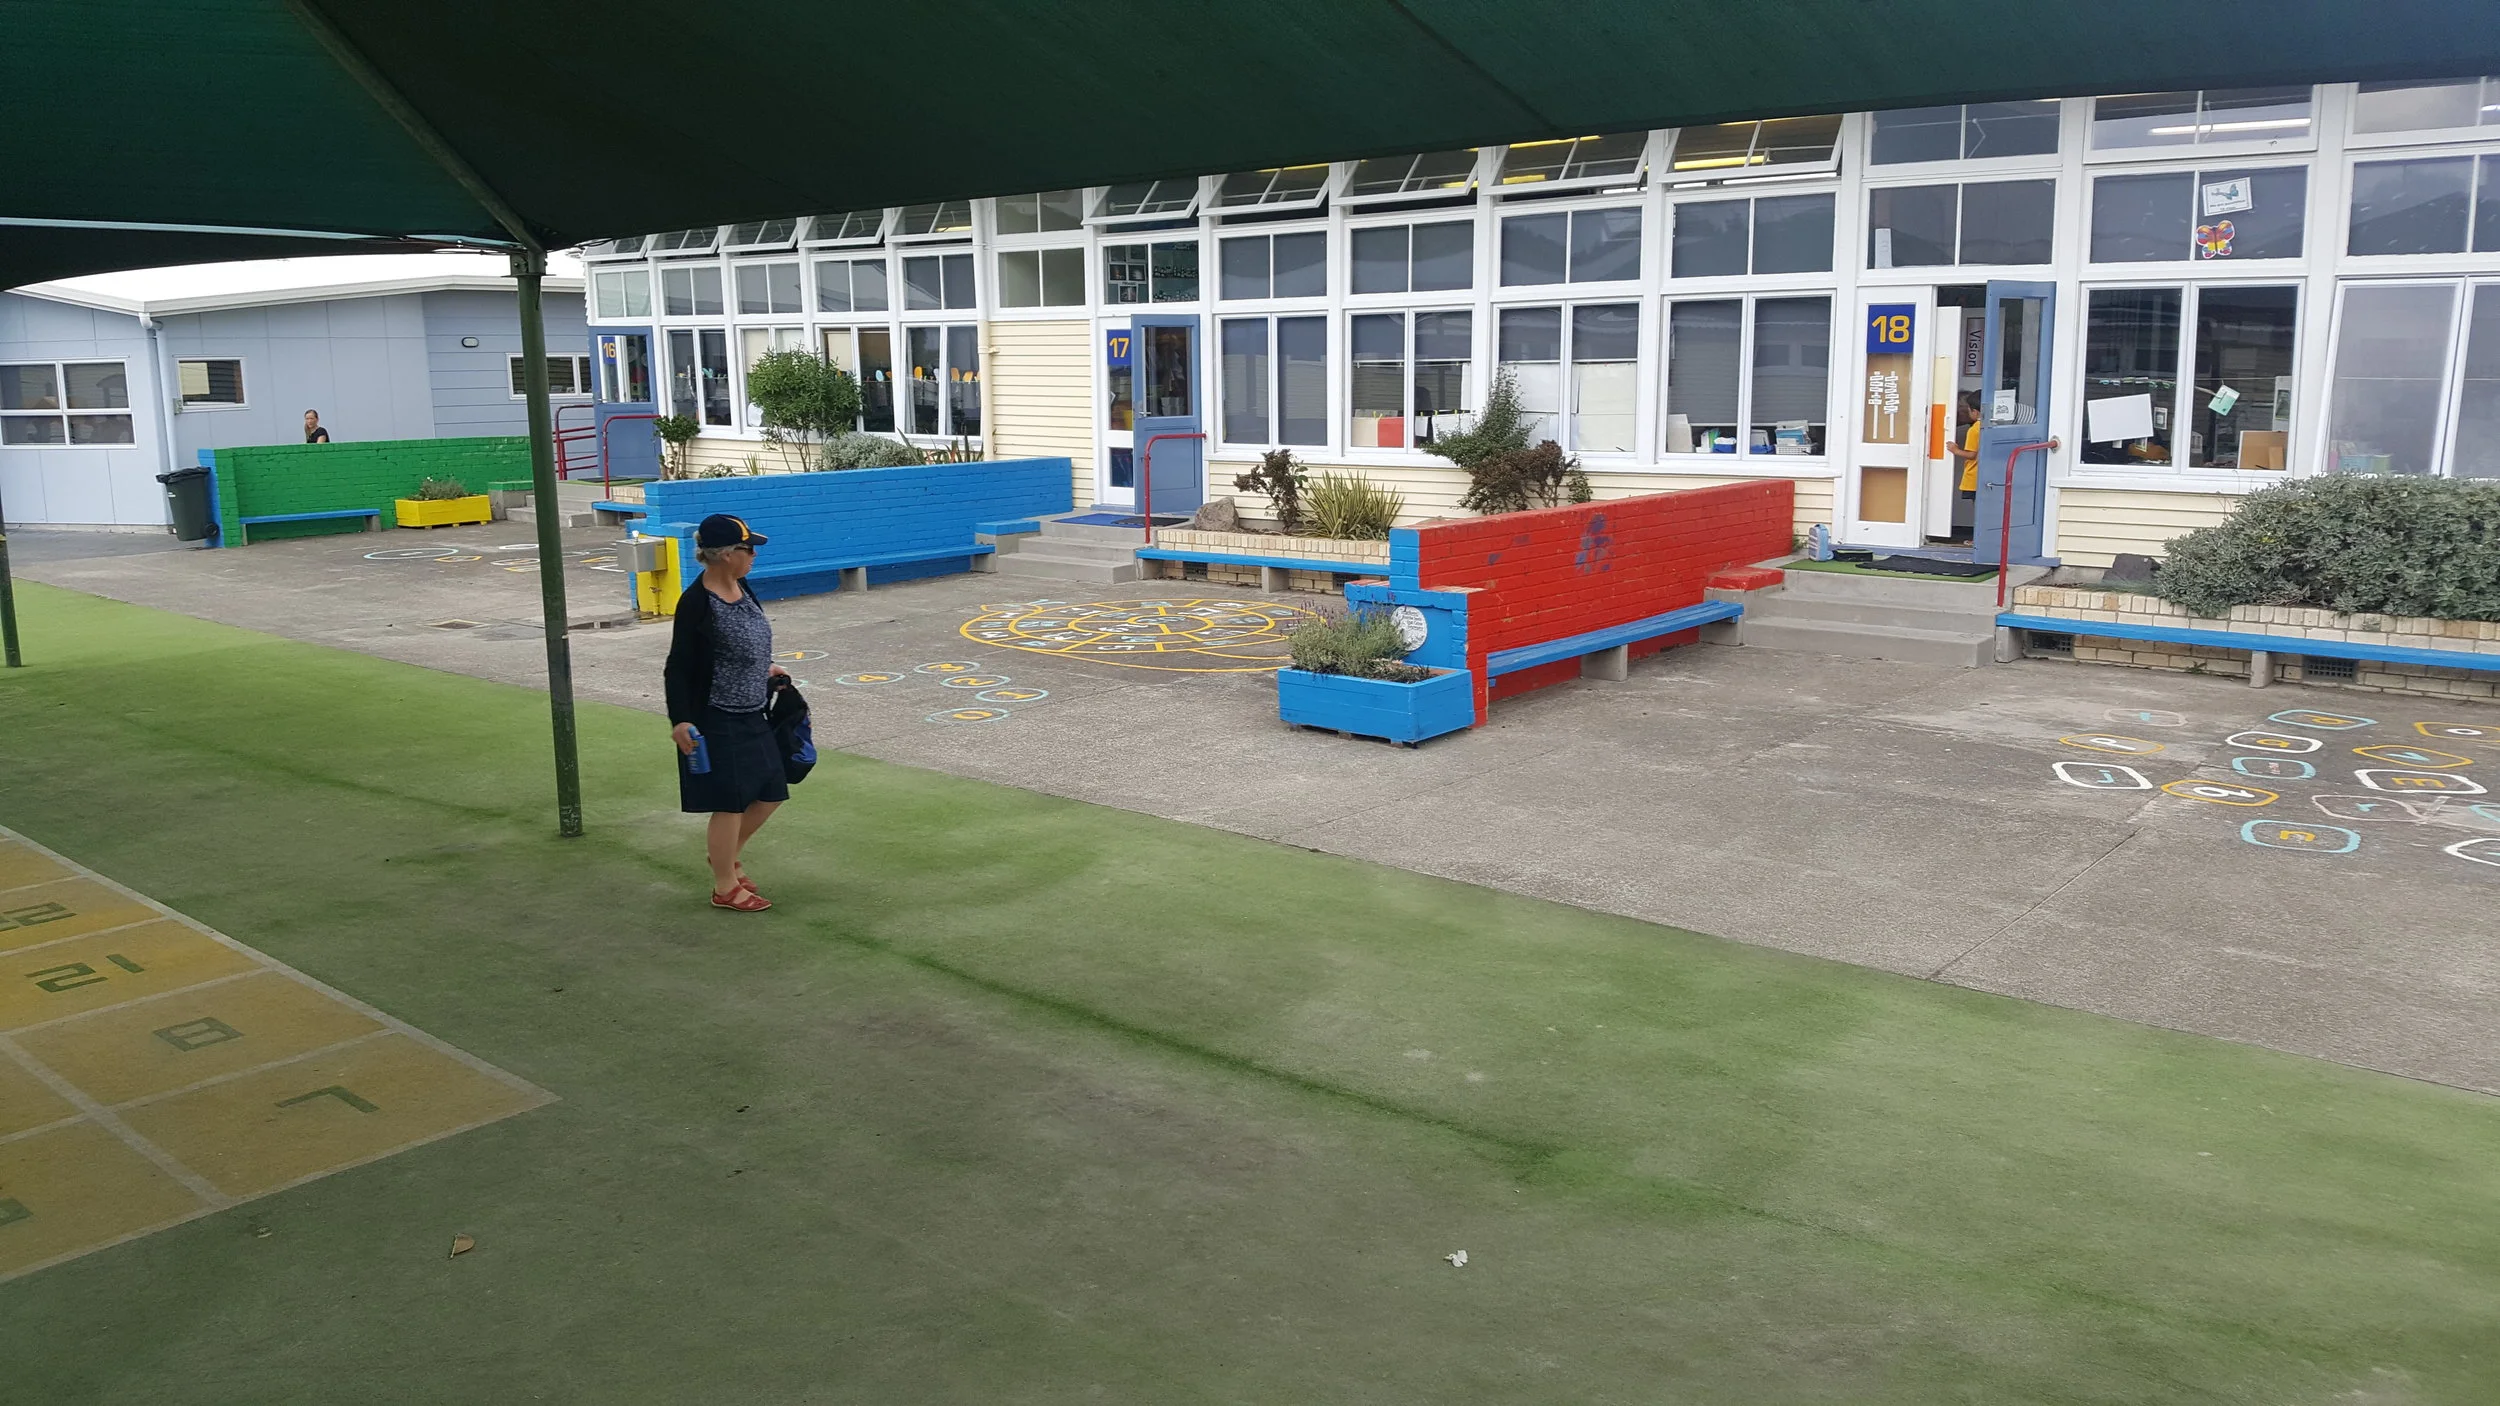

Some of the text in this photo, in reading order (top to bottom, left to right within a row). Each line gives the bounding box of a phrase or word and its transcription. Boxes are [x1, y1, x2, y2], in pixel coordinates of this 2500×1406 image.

[1872, 316, 1909, 342] 18
[603, 342, 616, 358] 16
[1109, 337, 1130, 358] 17
[1968, 330, 1982, 367] Vision
[927, 663, 966, 672] 3
[858, 674, 889, 683] 4
[952, 677, 995, 687] 2
[996, 691, 1038, 700] 1
[152, 1016, 245, 1052] 8
[274, 1084, 380, 1113] 7
